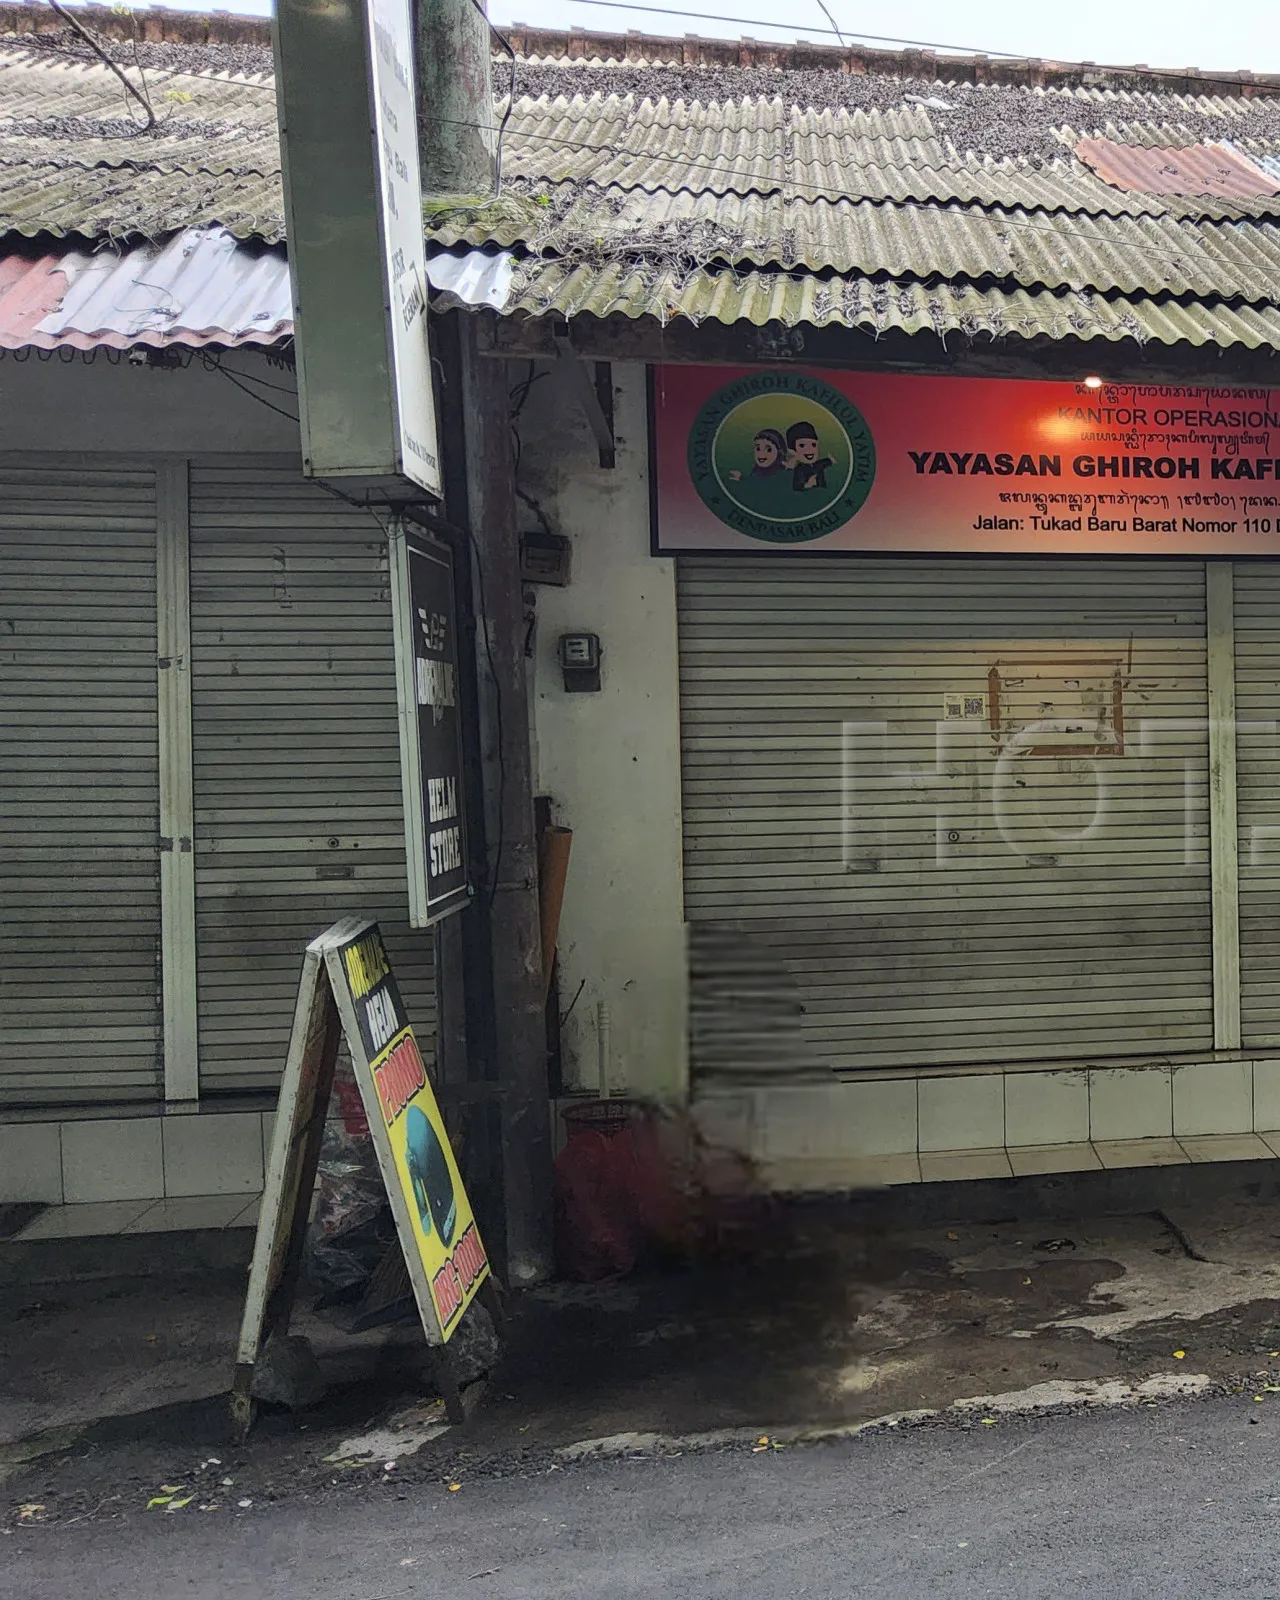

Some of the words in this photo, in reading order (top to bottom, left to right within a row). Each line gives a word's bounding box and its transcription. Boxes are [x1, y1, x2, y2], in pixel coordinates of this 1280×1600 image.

[720, 376, 789, 405] GHIROH
[795, 377, 858, 426] KAFILUL
[853, 431, 872, 483] YATIM
[1058, 406, 1148, 426] KANTOR
[908, 451, 1062, 478] YAYASAN
[1072, 455, 1200, 480] GHIROH
[726, 509, 807, 538] DENPASAR
[806, 510, 841, 536] BALI
[972, 515, 1025, 532] Jalan:
[1029, 516, 1082, 532] Tukad
[1088, 517, 1127, 532] Baru
[1133, 517, 1178, 533] Barat
[1183, 518, 1239, 533] Nomor
[1243, 518, 1271, 534] 110
[426, 775, 458, 824] HELM
[428, 826, 462, 878] STORE
[365, 985, 401, 1053] HELM
[373, 1031, 426, 1127] PROMO
[432, 1258, 462, 1331] ARC
[460, 1225, 490, 1294] 100K
